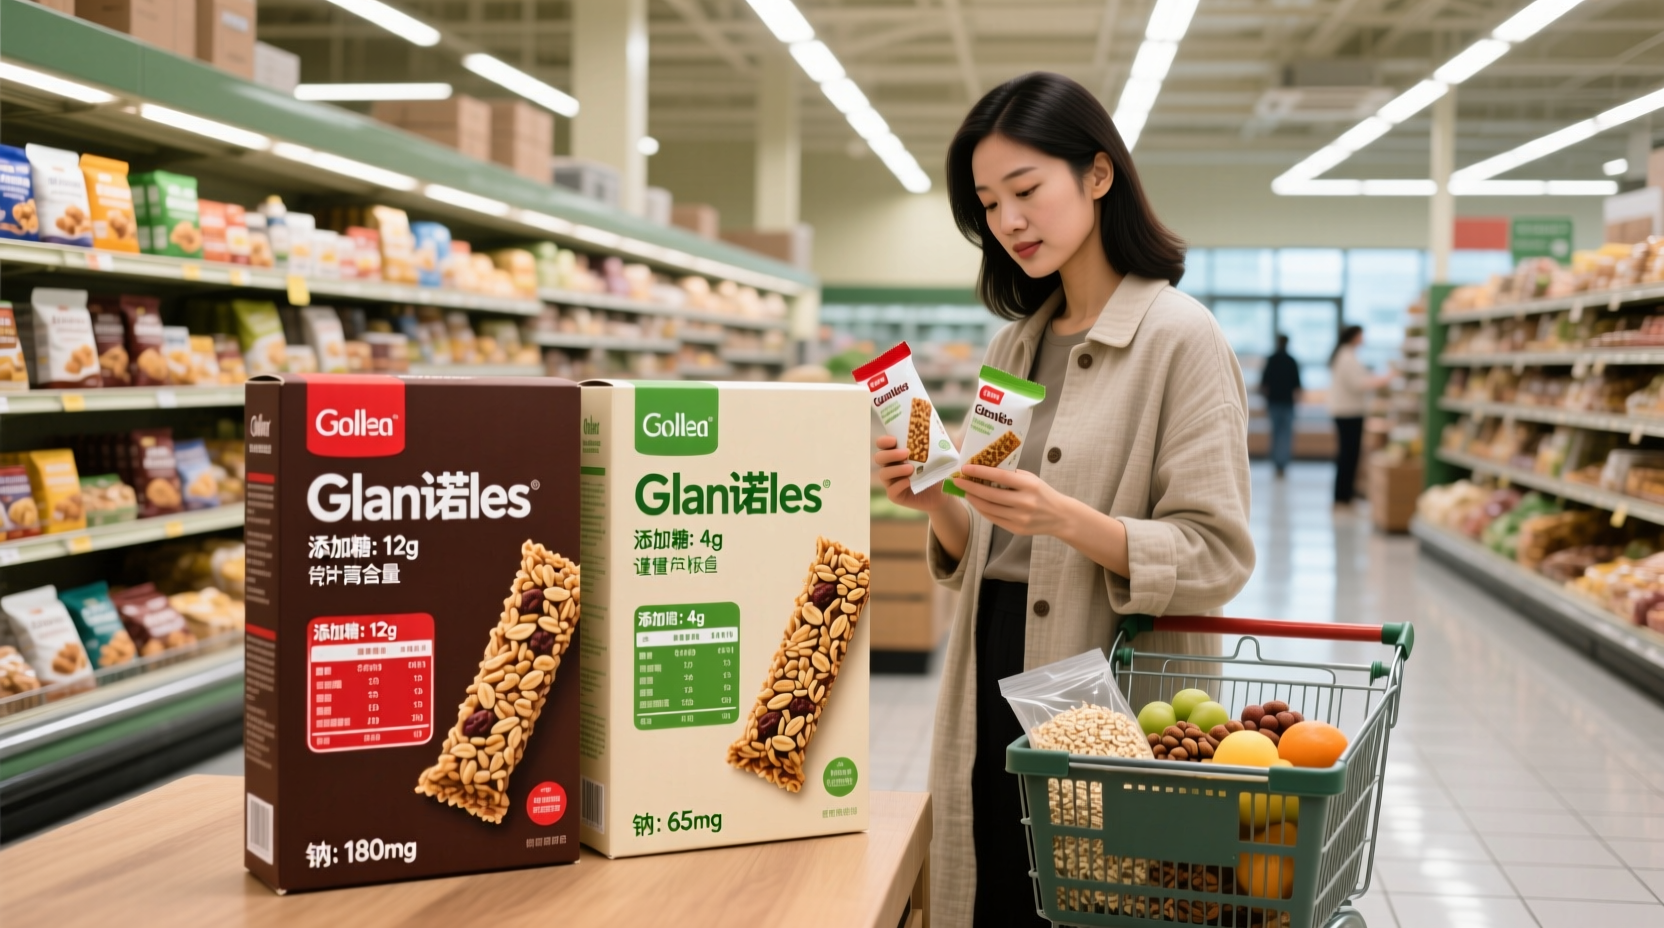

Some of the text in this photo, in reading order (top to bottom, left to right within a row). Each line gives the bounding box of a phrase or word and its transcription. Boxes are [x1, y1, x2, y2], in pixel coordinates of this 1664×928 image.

[383, 534, 419, 560] 12g
[700, 529, 723, 551] 4g
[687, 610, 705, 627] 4g
[369, 621, 397, 641] 12g
[667, 810, 722, 833] 65mg
[344, 838, 417, 863] 180mg
